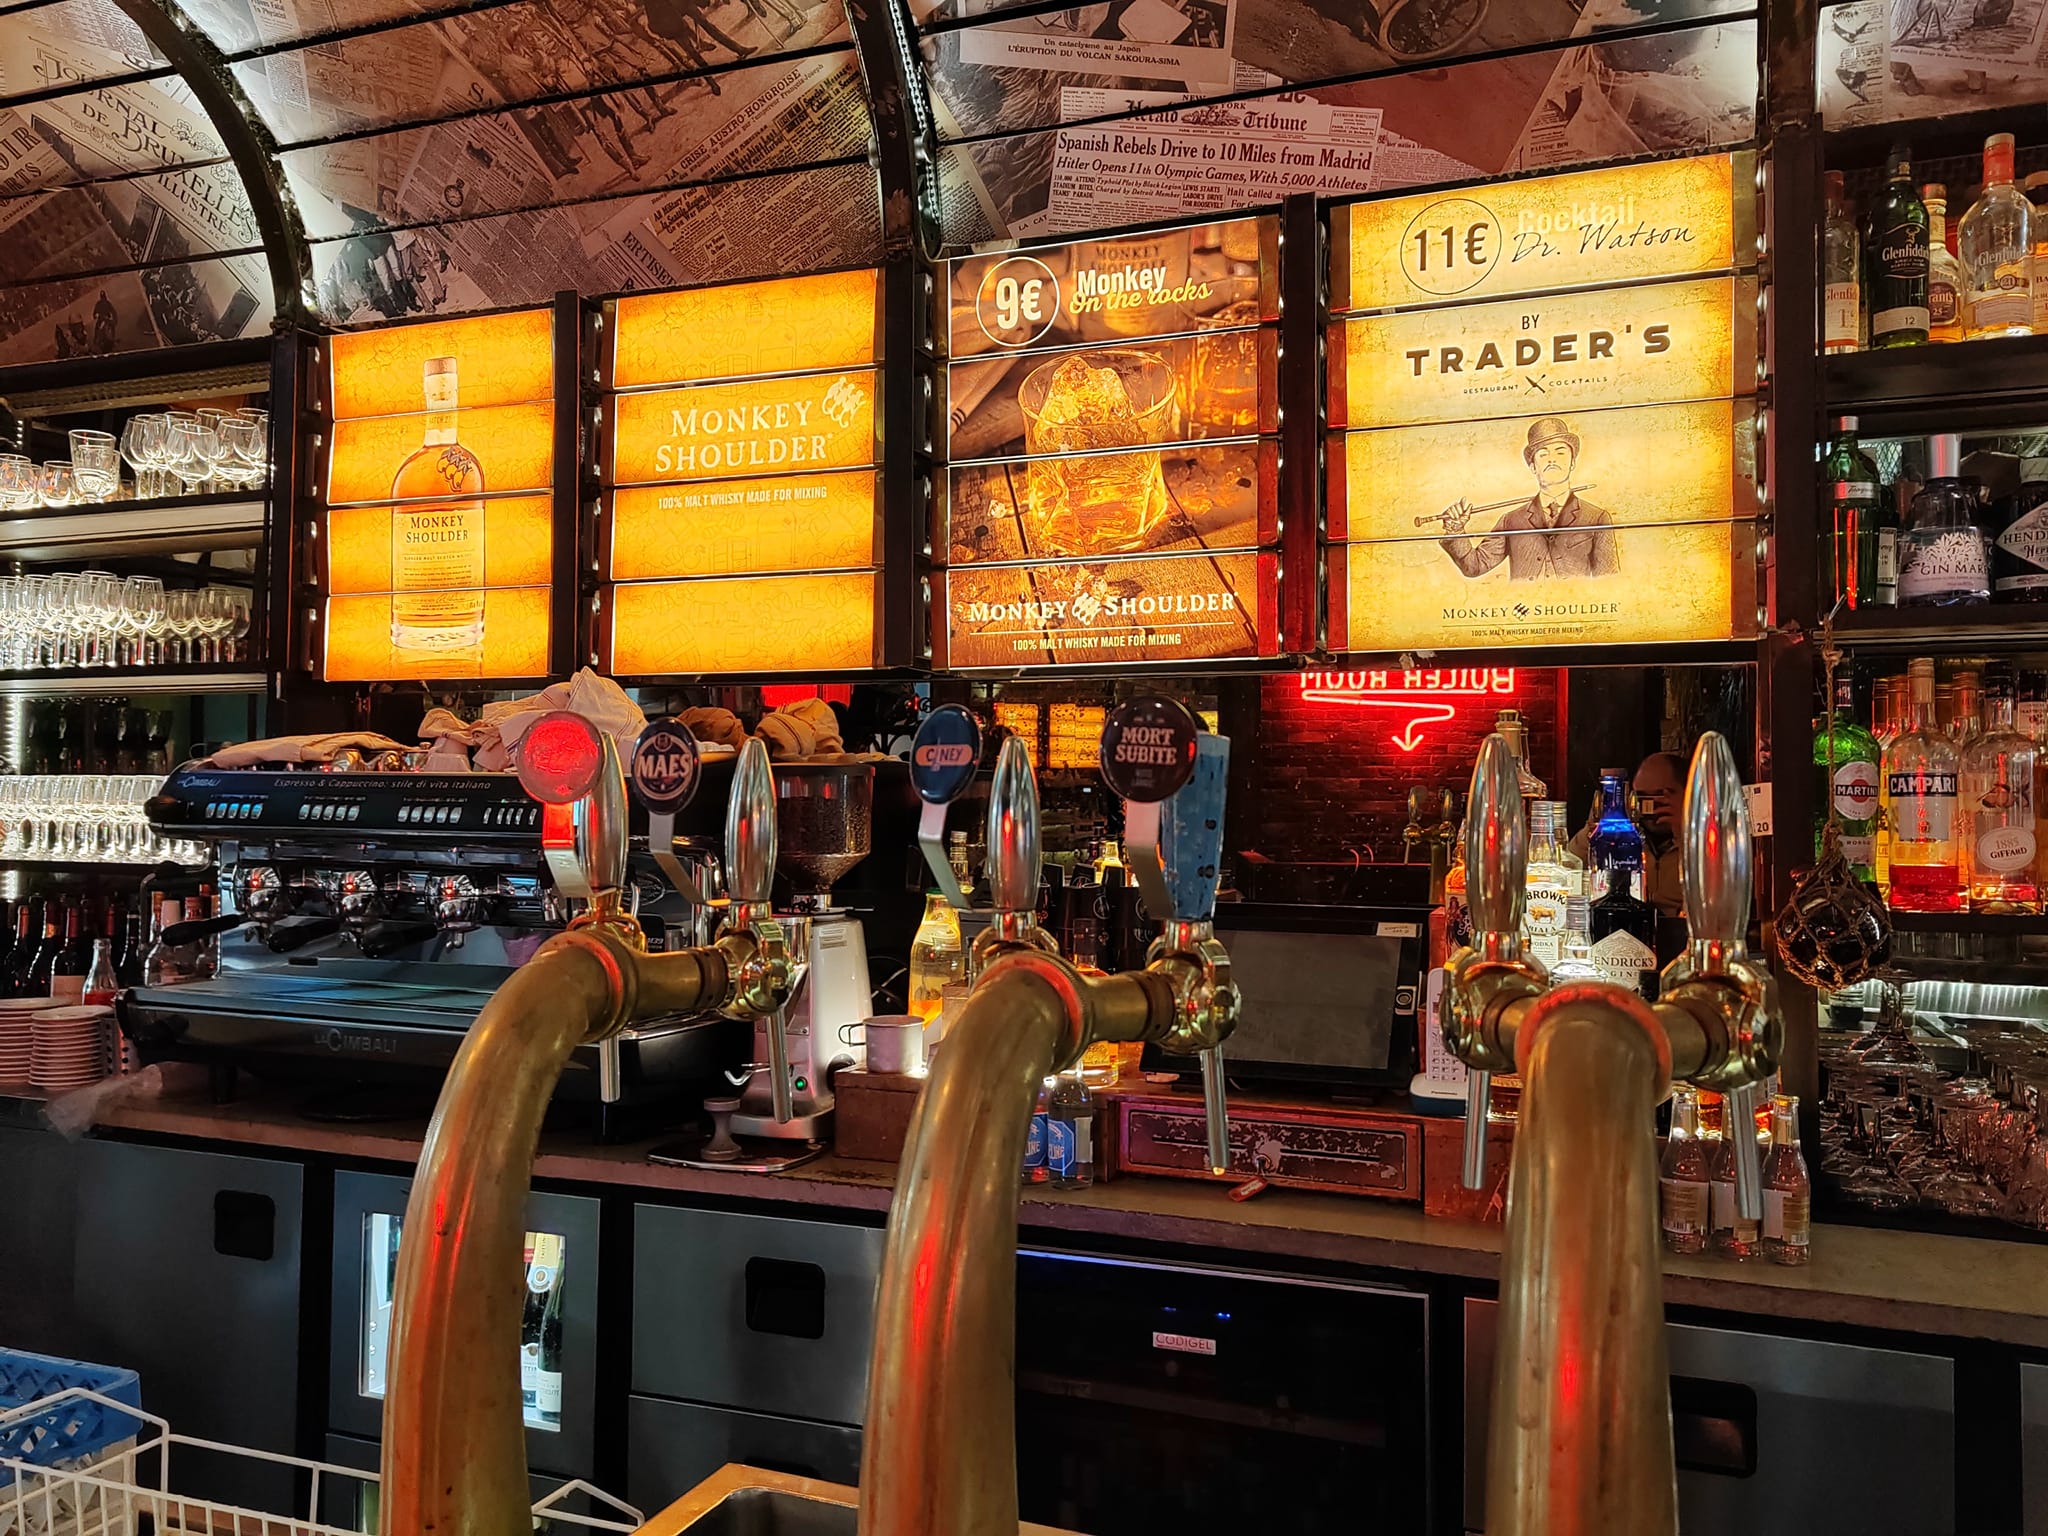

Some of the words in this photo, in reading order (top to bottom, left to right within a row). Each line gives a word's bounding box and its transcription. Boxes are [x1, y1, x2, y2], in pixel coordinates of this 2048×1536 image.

[1043, 38, 1057, 46] Un
[1059, 40, 1100, 51] cataclysme
[1060, 49, 1073, 57] DU
[1076, 50, 1112, 61] VOLCAN
[1114, 54, 1181, 66] SAKOURA-SIMA
[81, 103, 110, 128] DE
[665, 169, 679, 181] LA
[680, 144, 708, 169] CRISE
[709, 68, 802, 148] AUSTRO-HONGROISE
[1243, 111, 1308, 132] Tribune
[1058, 132, 1109, 153] Spanish
[1113, 135, 1157, 156] Rebels
[1160, 138, 1197, 158] Drive
[1202, 144, 1215, 160] to
[1219, 143, 1236, 161] 10
[1238, 143, 1276, 164] Miles
[1280, 150, 1315, 167] from
[1318, 148, 1372, 171] Madrid
[1056, 156, 1090, 170] Hitler
[1092, 159, 1127, 174] Opens
[1129, 162, 1152, 175] 11th
[1155, 163, 1203, 181] Olympic
[1205, 167, 1247, 184] Games,
[1249, 170, 1278, 184] With
[1280, 172, 1315, 188] 5,000
[1316, 175, 1368, 191] Athletes
[1247, 188, 1272, 199] Called
[1518, 195, 1635, 235] Cocktail
[1019, 223, 1029, 231] LA
[1414, 222, 1490, 272] 11€
[1511, 232, 1562, 263] Dr.
[1578, 220, 1697, 256] Watson
[1882, 243, 1929, 261] Glenfiddi
[1077, 265, 1168, 297] Monkey
[2002, 278, 2013, 287] 21
[996, 277, 1042, 330] 9€
[1069, 292, 1102, 314] On
[1106, 288, 1142, 310] the
[1145, 278, 1213, 308] rocks
[1904, 316, 1915, 325] 12
[1932, 308, 1943, 316] 25
[1522, 314, 1540, 330] BY
[1406, 324, 1671, 377] TRADER'S
[1463, 384, 1520, 395] RESTAURANT
[1550, 376, 1608, 387] COCKTAILS
[671, 400, 812, 438] MONKEY
[656, 434, 827, 473] SHOULDER
[658, 496, 683, 510] 100%
[685, 493, 708, 508] MALT
[710, 491, 745, 506] WHISKY
[746, 490, 771, 503] MADE
[774, 489, 792, 501] FOR
[794, 487, 828, 500] MIXING
[411, 515, 464, 529] MONKEY
[406, 529, 469, 543] SHOULDER
[2003, 530, 2048, 544] HEND
[1920, 562, 1950, 577] GIN
[968, 600, 1068, 623] MONKEY
[1104, 593, 1235, 616] SHOULDER
[1442, 607, 1509, 620] MONKEY
[1534, 603, 1618, 617] SHOULDER
[1471, 629, 1487, 637] 100%
[1506, 628, 1529, 636] WHISKY
[1530, 627, 1547, 635] MADE
[1562, 626, 1583, 634] MIXING
[1012, 639, 1038, 652] 100%
[1039, 637, 1063, 650] MALT
[1065, 637, 1098, 649] WHISKY
[1100, 635, 1125, 648] MADE
[1127, 634, 1146, 646] FOR
[1148, 633, 1181, 646] MIXING
[1121, 726, 1175, 746] MORT
[1115, 744, 1177, 766] SUBITE
[637, 753, 691, 779] MAES
[274, 779, 316, 788] Espresso
[318, 779, 325, 787] &
[391, 780, 413, 789] stile
[416, 780, 427, 788] di
[430, 780, 449, 789] vita
[451, 781, 491, 790] italiano
[1837, 785, 1878, 796] MARTINI
[1890, 776, 1956, 794] CAMPARI
[1756, 821, 1769, 833] 20
[1995, 837, 2020, 850] 1885
[1990, 847, 2028, 859] GIFFARD
[1594, 956, 1655, 968] ENDRICK'S
[1610, 970, 1633, 978] GIN
[327, 1028, 398, 1053] CIMBALI
[1156, 1334, 1213, 1350] CODIGEL
